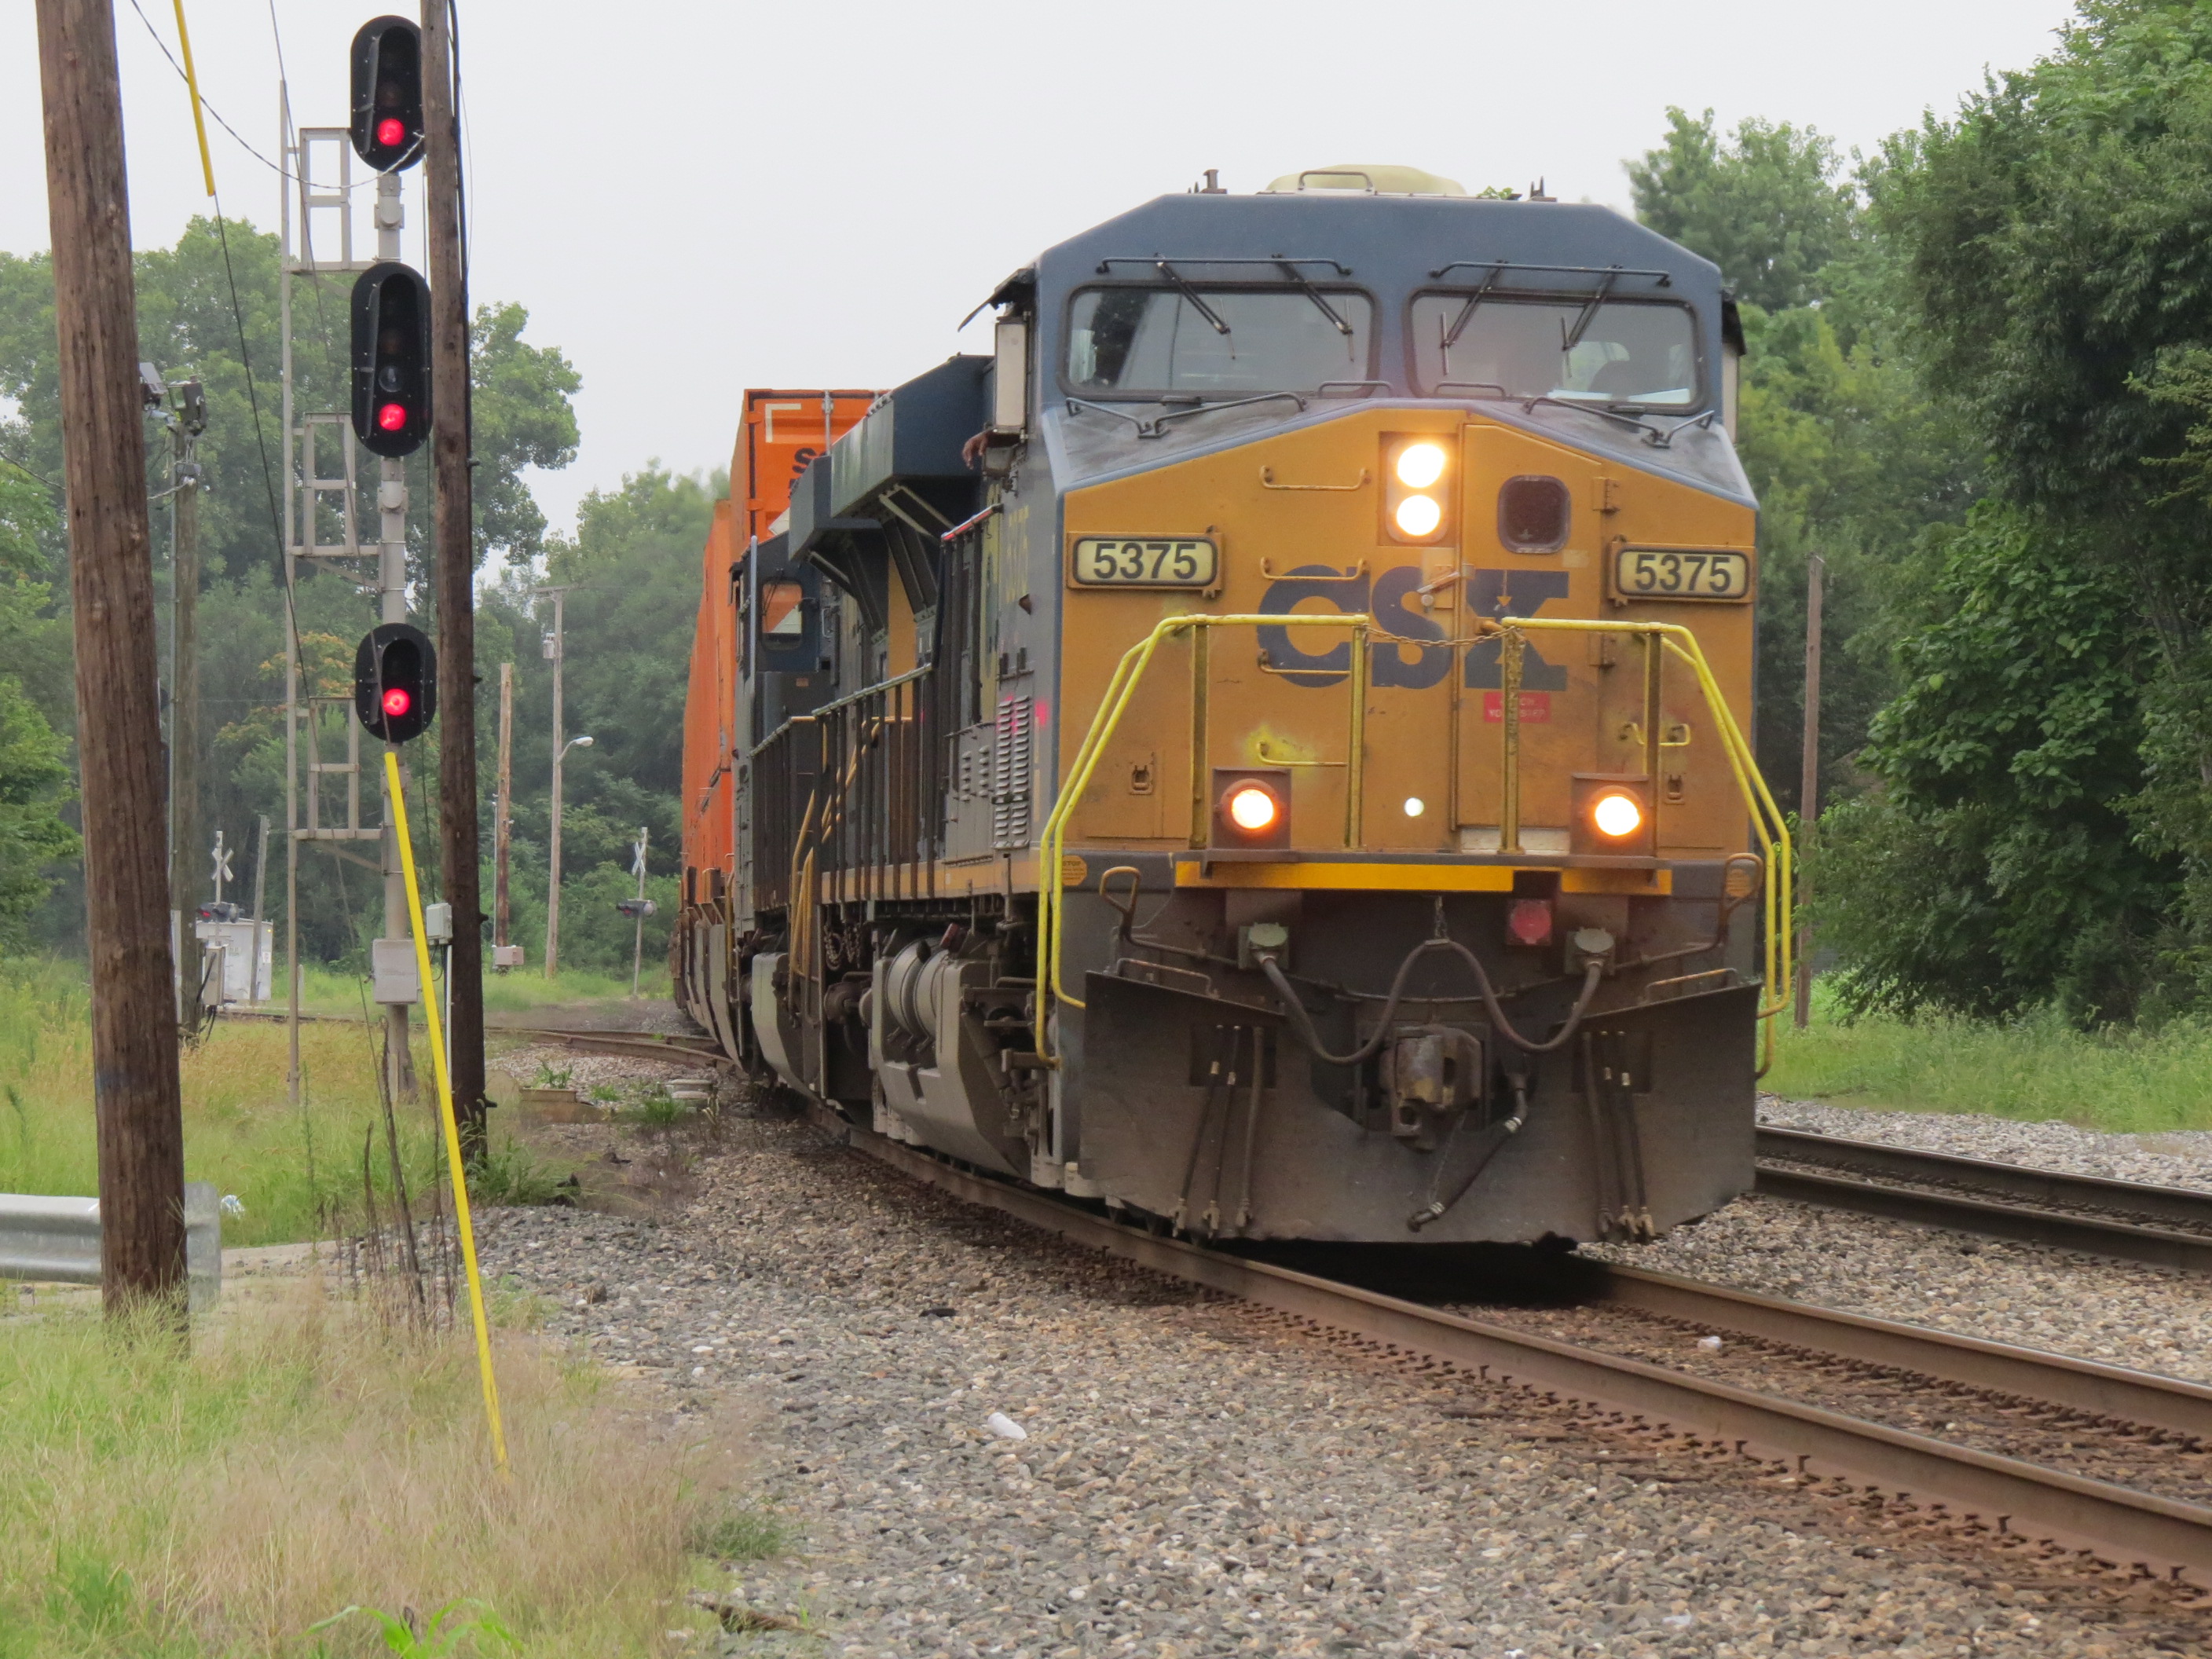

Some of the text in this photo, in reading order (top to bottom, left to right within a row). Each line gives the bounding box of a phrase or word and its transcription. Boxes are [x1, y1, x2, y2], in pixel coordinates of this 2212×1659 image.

[1093, 542, 1197, 579] 5375
[1635, 554, 1731, 592] 5375
[1258, 564, 1569, 691] CSX
